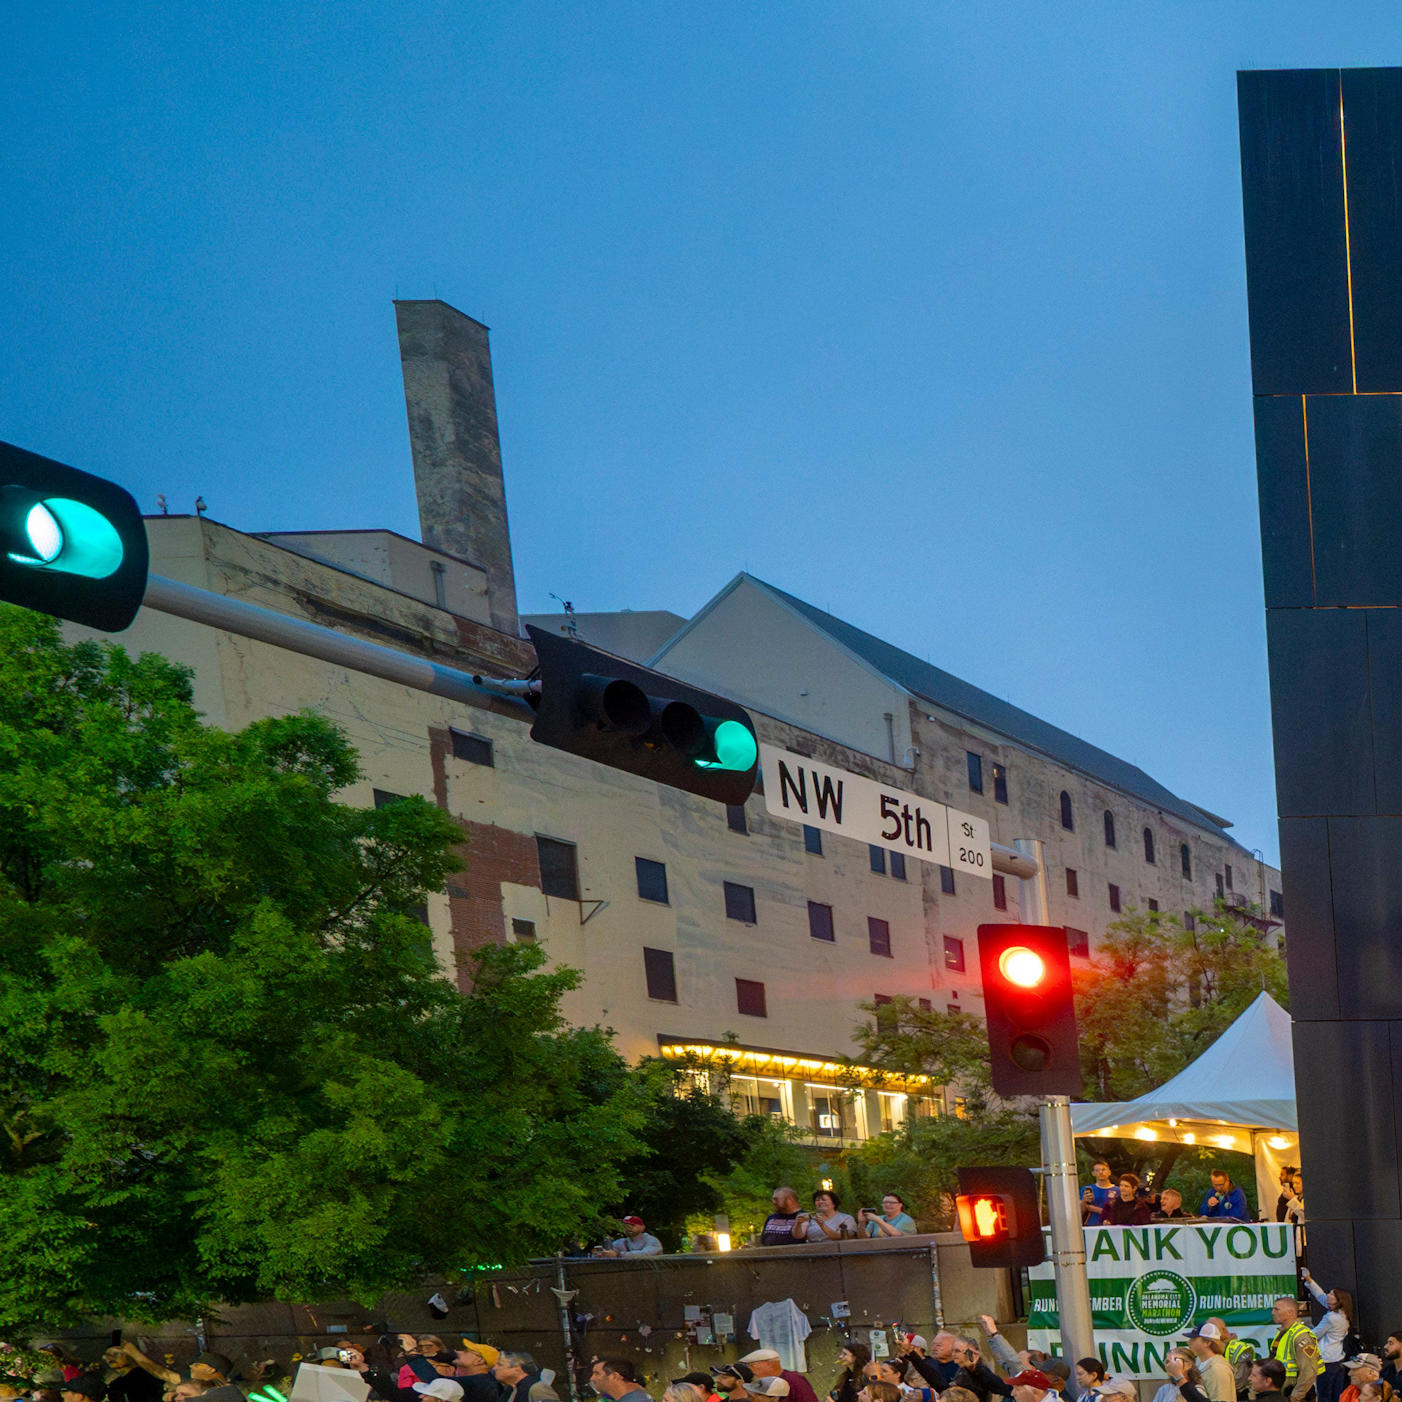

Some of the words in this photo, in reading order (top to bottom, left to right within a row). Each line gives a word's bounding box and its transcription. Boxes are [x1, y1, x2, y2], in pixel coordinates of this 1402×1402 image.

[778, 759, 844, 825] NW
[879, 794, 933, 852] 5th
[960, 822, 976, 840] St
[959, 847, 984, 868] 200
[1195, 1225, 1289, 1260] YOU
[1141, 1300, 1181, 1309] MEMORIAL
[1141, 1309, 1181, 1317] MARATHON
